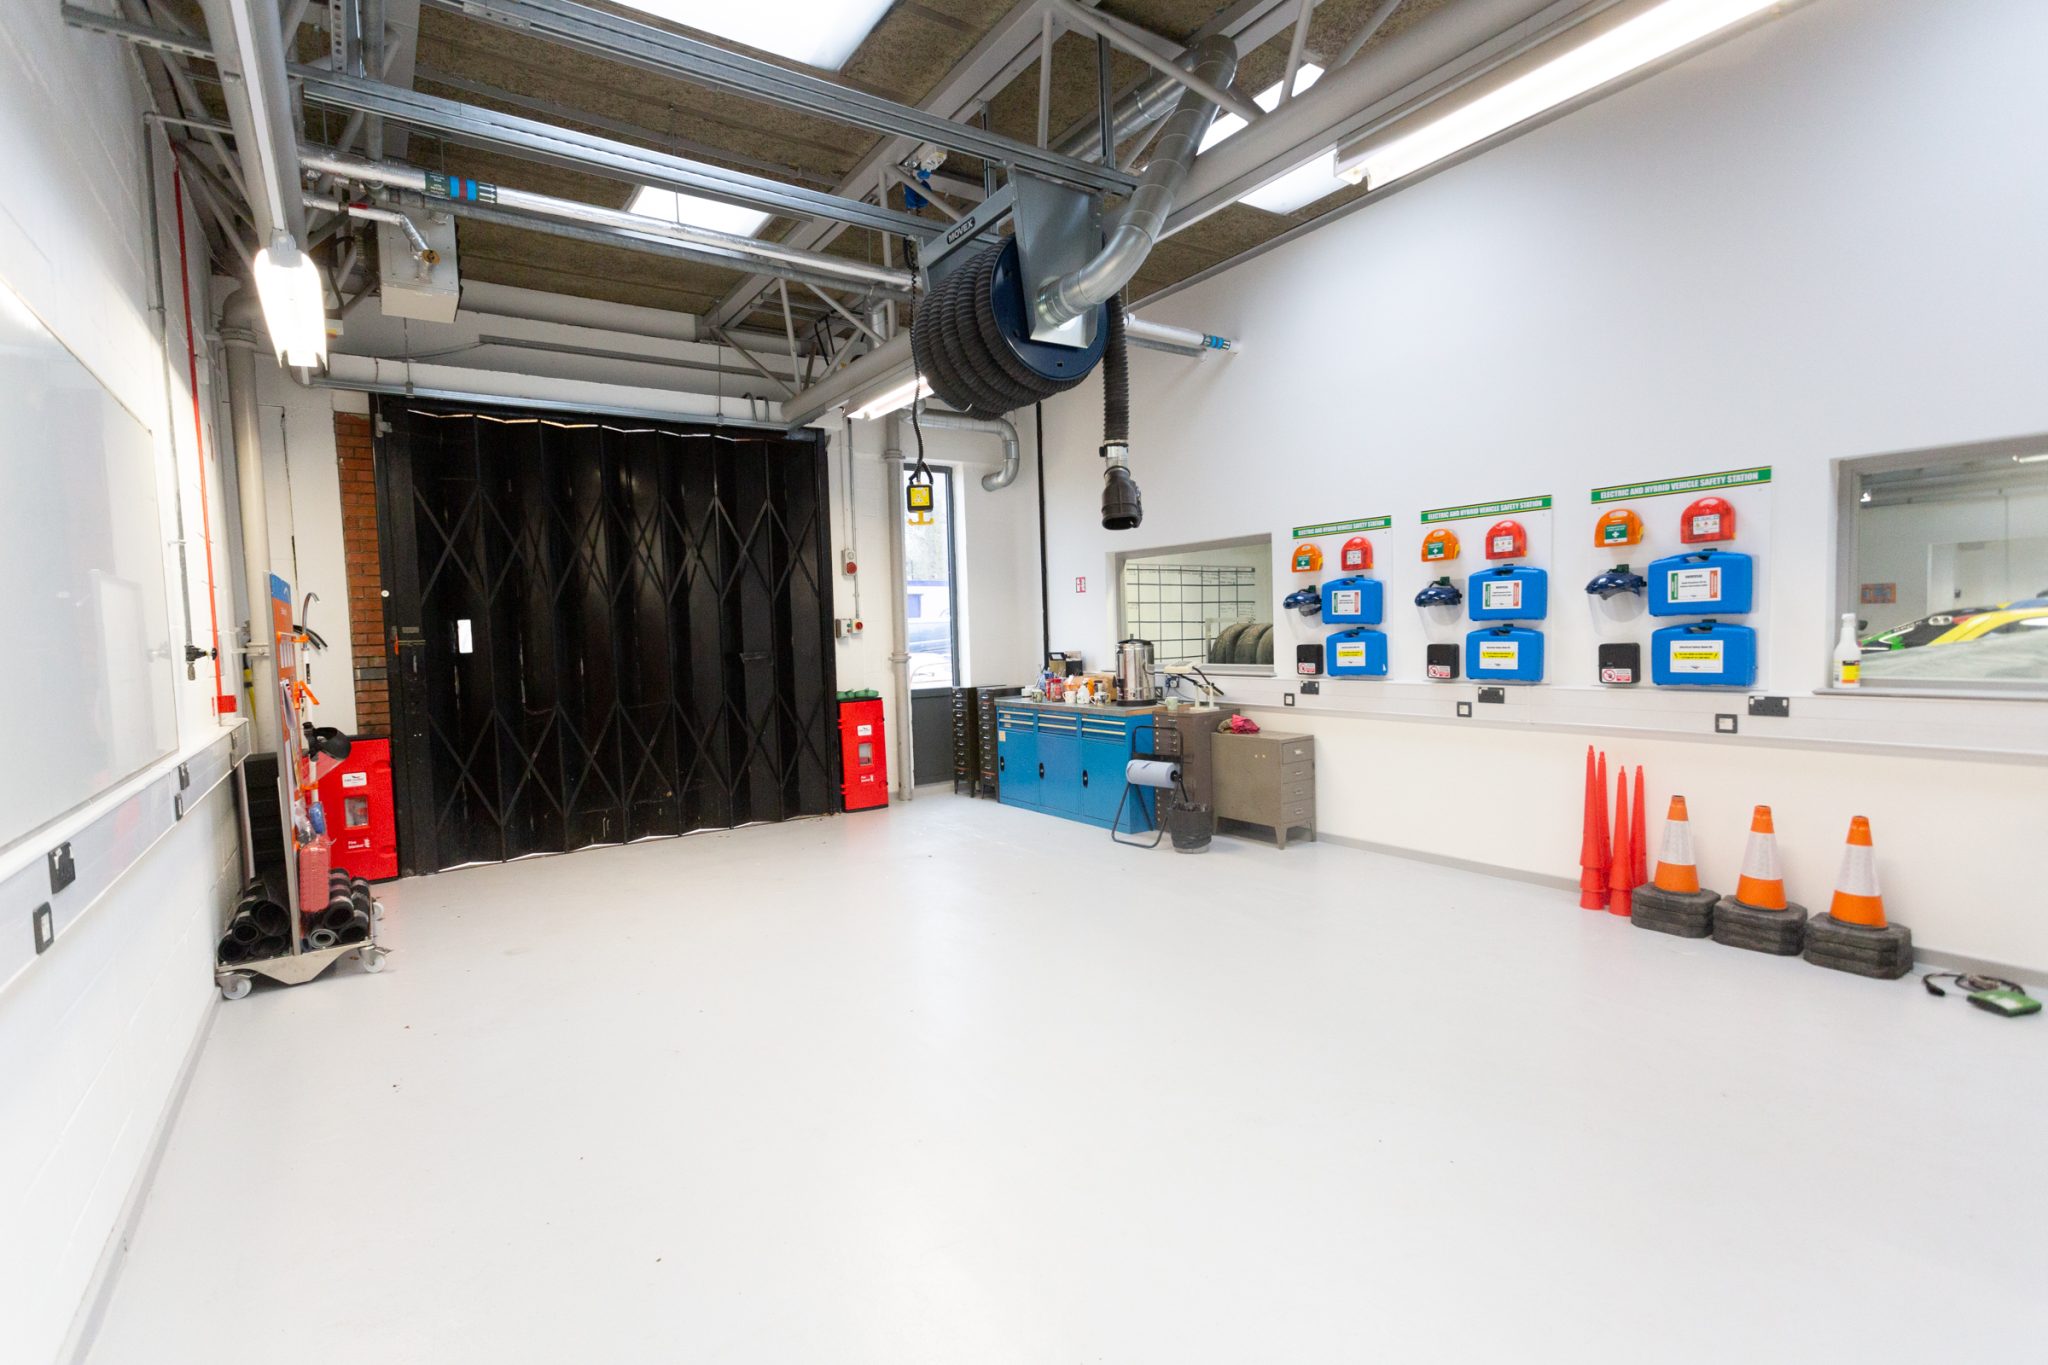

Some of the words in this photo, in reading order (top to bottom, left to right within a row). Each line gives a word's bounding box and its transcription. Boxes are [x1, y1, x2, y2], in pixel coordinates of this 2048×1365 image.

[948, 219, 974, 243] MOVEX
[1600, 486, 1629, 499] ELECTRIC
[1630, 485, 1644, 495] AND
[1645, 482, 1670, 493] HYBRID
[1671, 480, 1699, 490] VEHICLE
[1700, 476, 1726, 486] SAFETY
[1727, 472, 1759, 484] STATION
